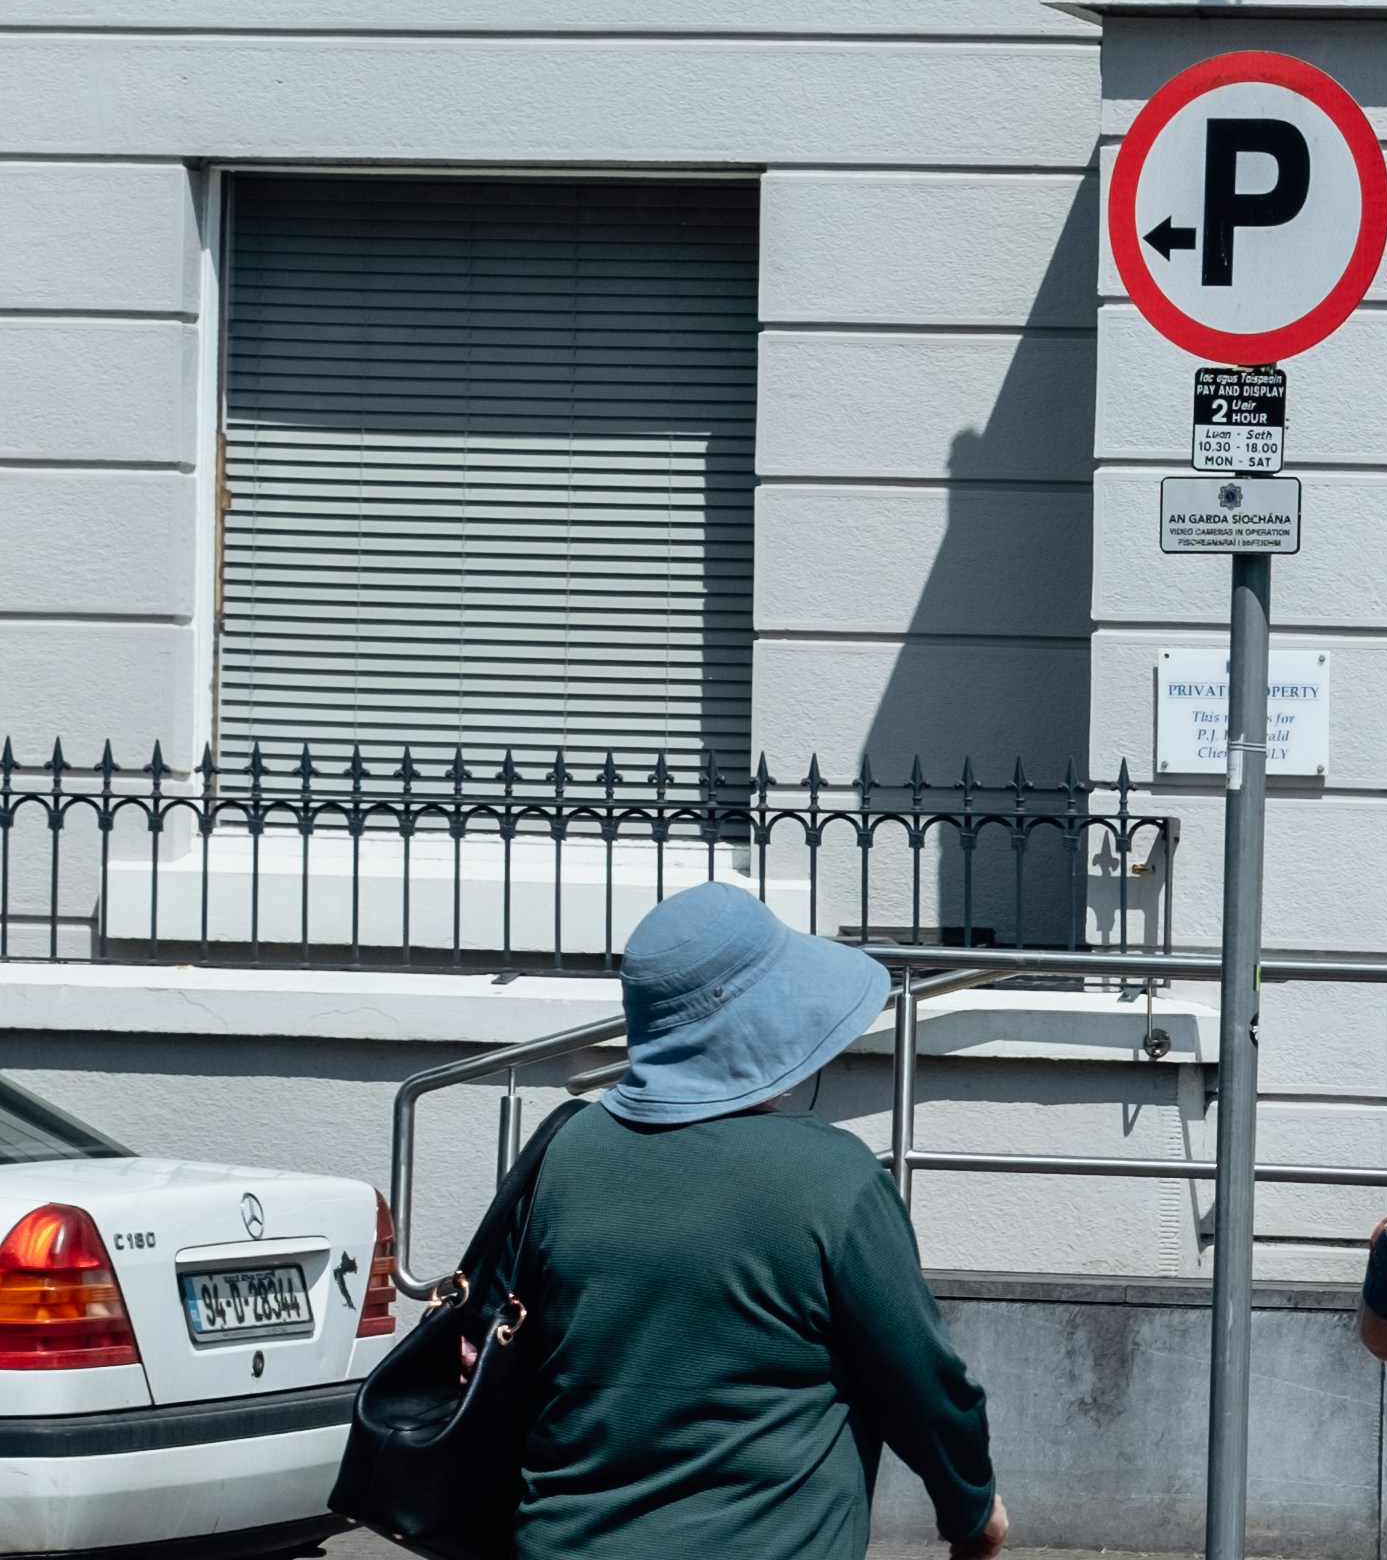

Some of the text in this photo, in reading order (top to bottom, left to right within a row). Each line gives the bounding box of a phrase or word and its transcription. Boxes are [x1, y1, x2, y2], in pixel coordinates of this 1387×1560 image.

[1200, 117, 1312, 288] P
[1196, 384, 1285, 398] PAY AND DISPLAY
[1211, 398, 1257, 423] 2 Uair
[1231, 413, 1268, 424] HOUR
[1205, 428, 1232, 439] Luan
[1199, 441, 1231, 452] 10.30
[1245, 443, 1278, 454] 18.00
[1204, 455, 1233, 466] MON
[1248, 457, 1272, 468] SAT
[1168, 514, 1186, 524] AN
[1188, 514, 1229, 524] GARDA
[1169, 528, 1194, 536] VIDEO
[1235, 528, 1243, 536] IN
[1245, 528, 1290, 537] OPERATION
[1168, 684, 1230, 698] PRIVAT
[201, 1277, 301, 1327] 94-D-28344
